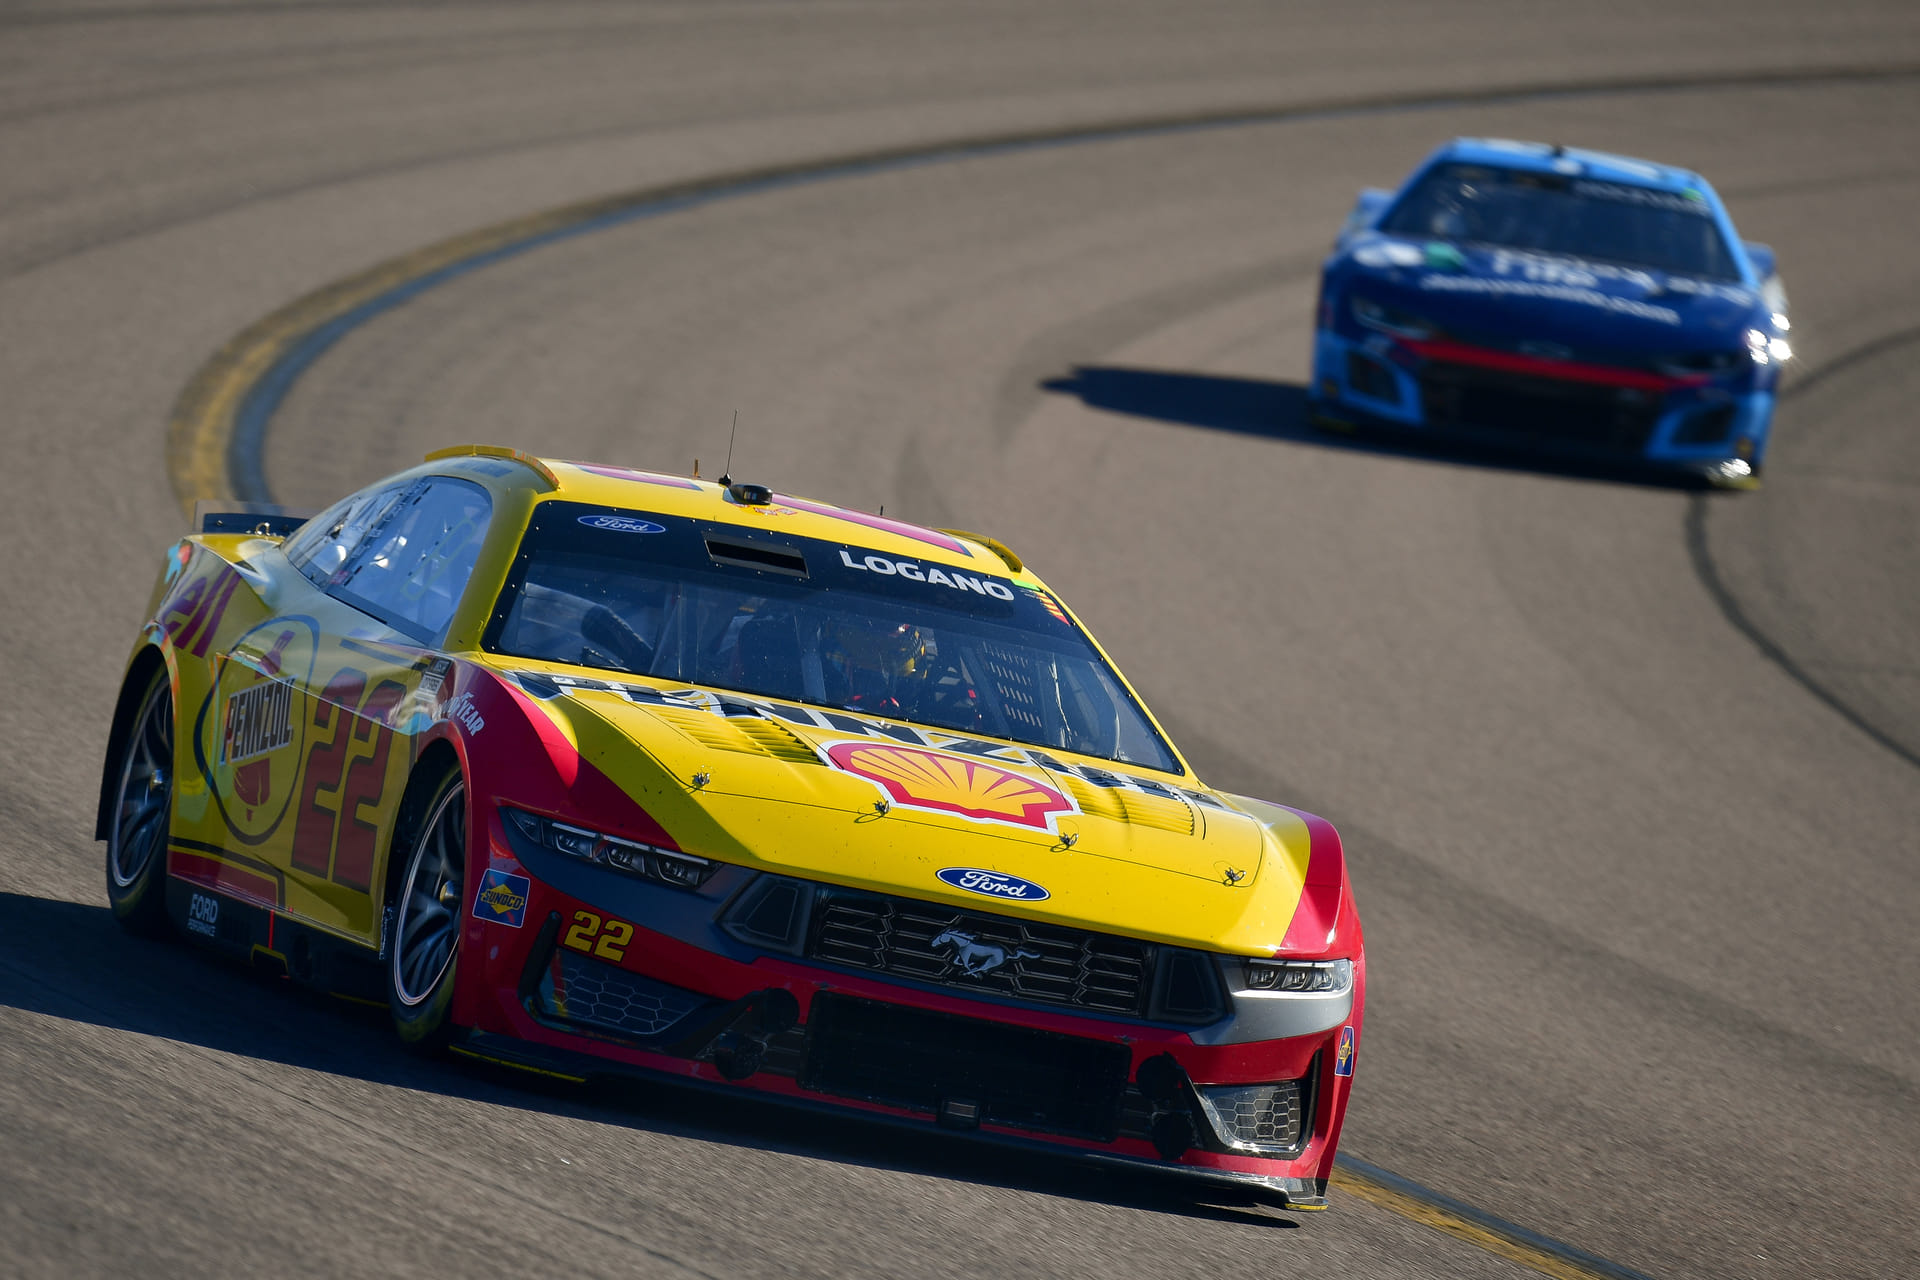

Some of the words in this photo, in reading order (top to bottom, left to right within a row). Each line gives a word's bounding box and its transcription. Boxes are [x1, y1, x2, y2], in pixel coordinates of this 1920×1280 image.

[594, 517, 648, 531] Ford
[839, 550, 1014, 600] LOGANO
[220, 674, 299, 766] PENNZOIL
[291, 667, 406, 896] 22
[483, 888, 524, 909] SUNOCO
[959, 871, 1027, 897] Ford
[190, 893, 218, 924] FORD
[564, 911, 634, 962] 22
